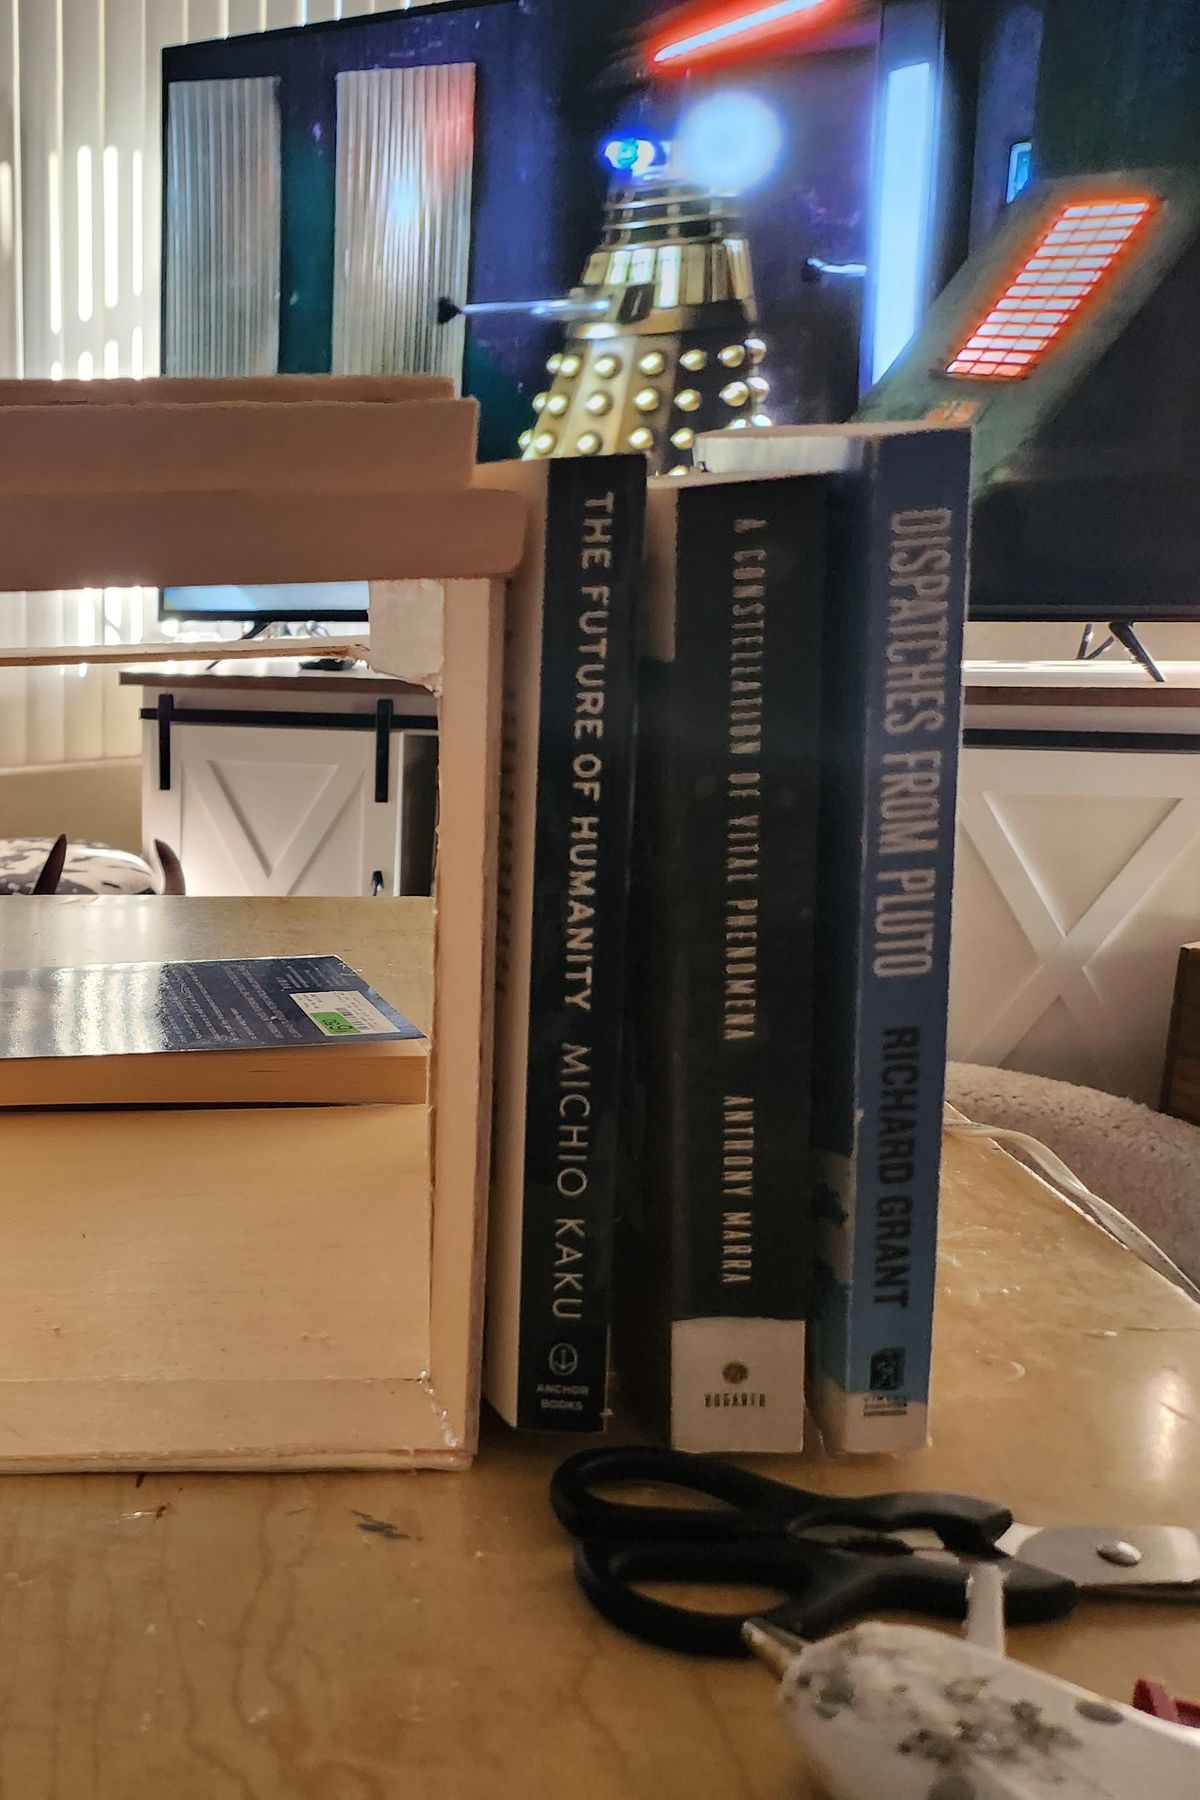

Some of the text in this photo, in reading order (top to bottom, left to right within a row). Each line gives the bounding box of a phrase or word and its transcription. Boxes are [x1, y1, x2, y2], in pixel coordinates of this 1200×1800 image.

[564, 491, 615, 1012] THE FUTURE OF HUMANITY
[723, 518, 768, 1041] A CONSTELLATION OF VITAL PHENOMENA
[872, 508, 952, 978] DISPATCHES FROM PLUTO
[552, 1042, 592, 1320] MICHIO KAKU
[722, 1095, 754, 1284] ANTHONY MARRA
[872, 1024, 921, 1309] RICHARD GRANT
